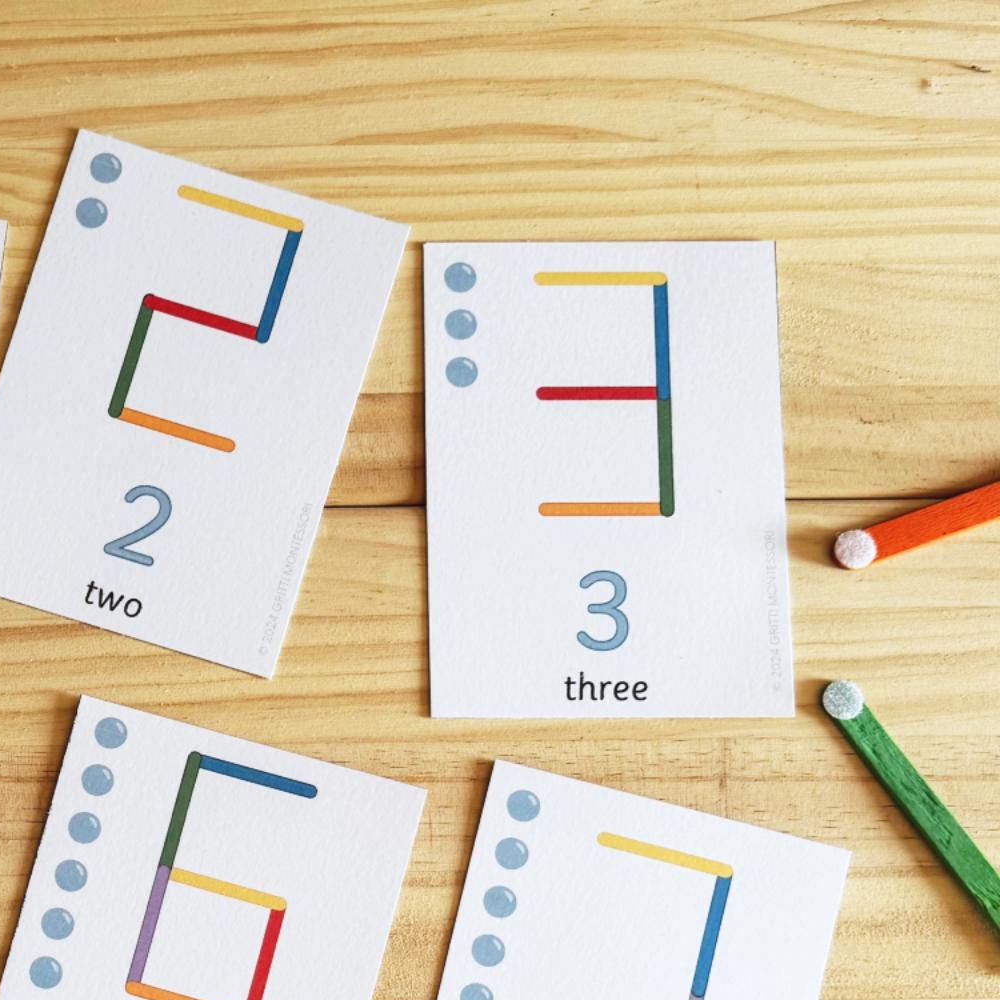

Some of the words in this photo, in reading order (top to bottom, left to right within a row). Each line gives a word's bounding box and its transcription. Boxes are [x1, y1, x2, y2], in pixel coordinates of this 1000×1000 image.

[104, 485, 172, 567] 2
[85, 581, 142, 617] two
[261, 614, 278, 644] 2024
[283, 502, 313, 579] MONTESSORI
[576, 570, 630, 653] 3
[565, 672, 647, 700] three
